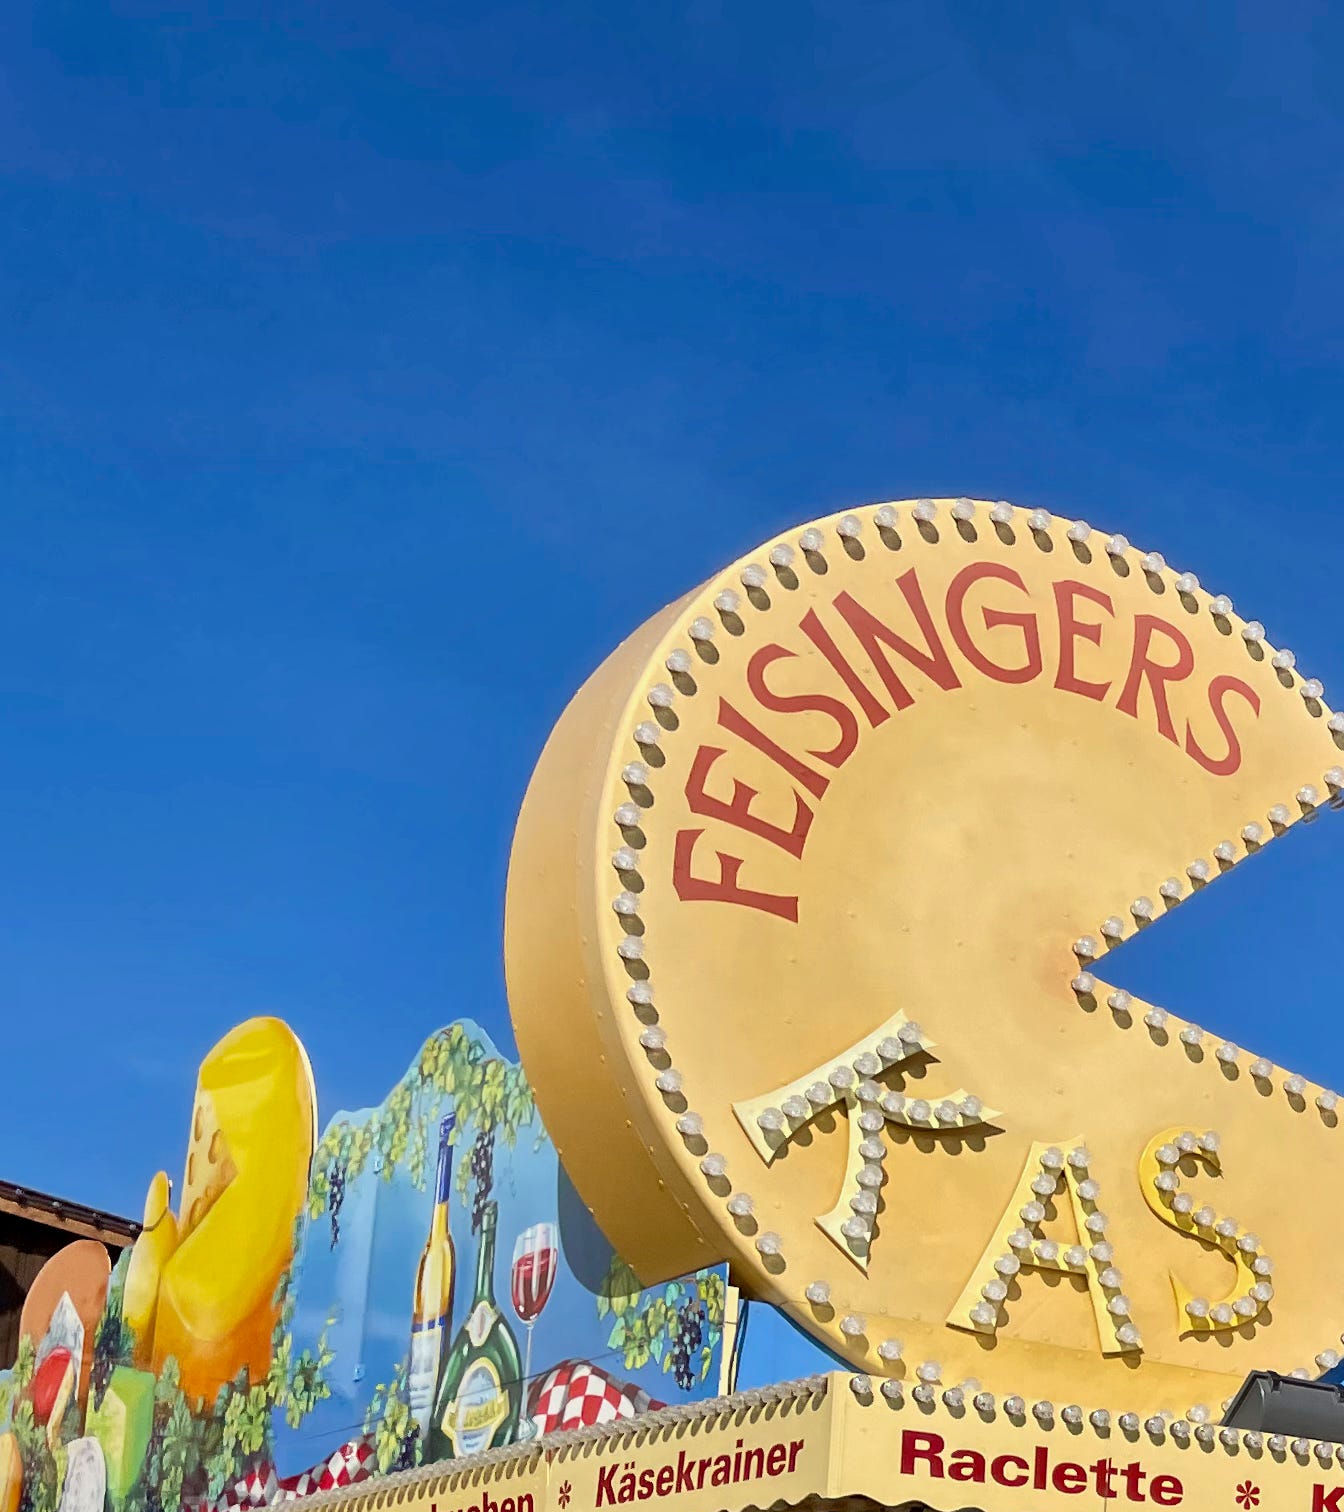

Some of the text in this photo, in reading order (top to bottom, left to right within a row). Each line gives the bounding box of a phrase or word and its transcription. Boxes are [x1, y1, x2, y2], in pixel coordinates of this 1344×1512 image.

[672, 562, 1261, 923] FEISINGERS
[595, 1439, 804, 1508] Käsekrainer
[900, 1430, 1184, 1506] Raclette
